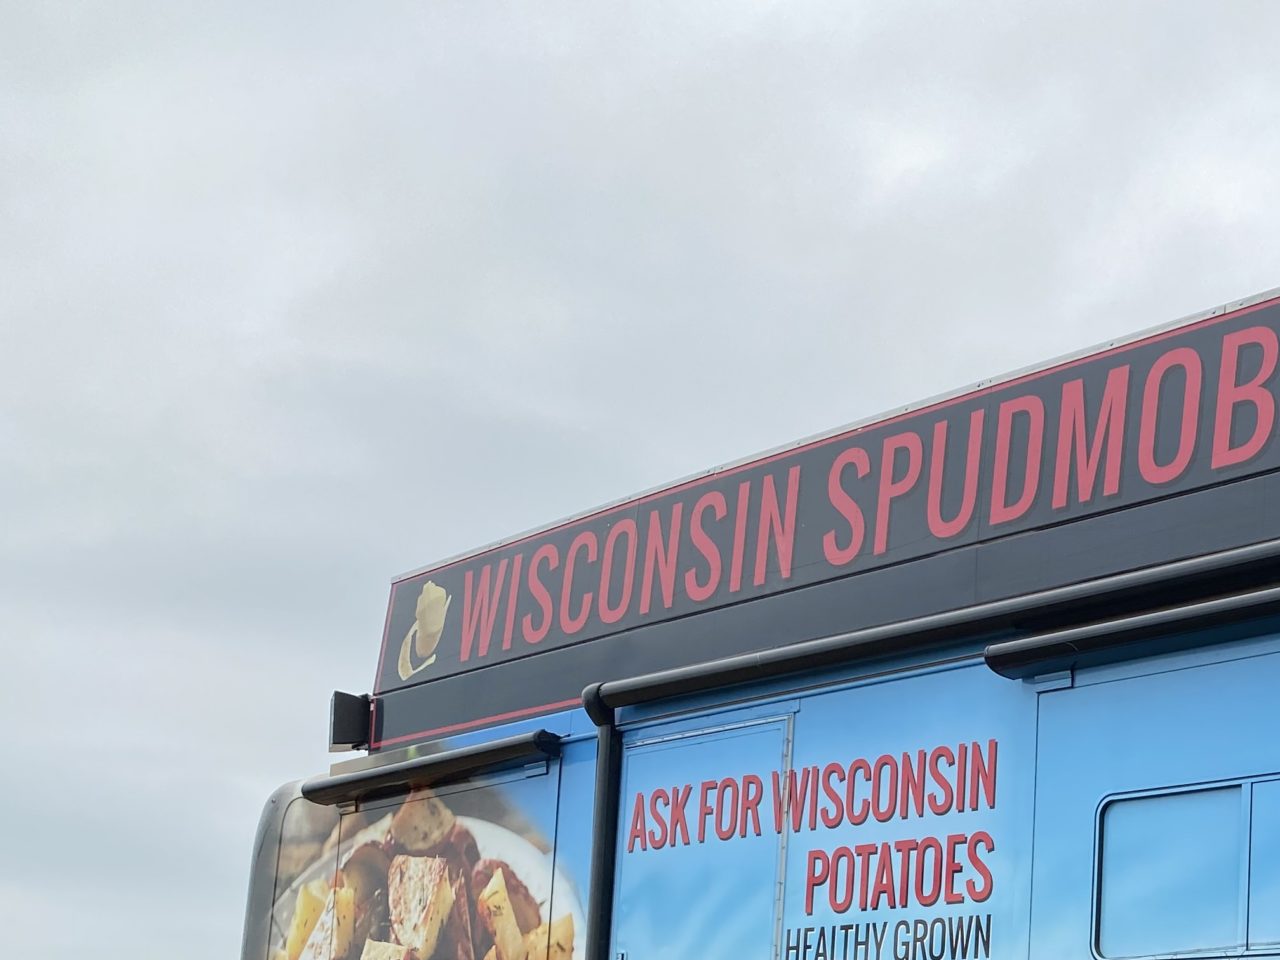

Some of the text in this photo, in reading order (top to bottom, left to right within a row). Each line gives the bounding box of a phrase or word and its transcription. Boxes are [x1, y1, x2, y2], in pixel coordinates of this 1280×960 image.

[459, 465, 801, 662] WISCONSIN
[627, 738, 998, 853] ASK FOR WISCONSIN
[805, 831, 995, 916] POTATOES
